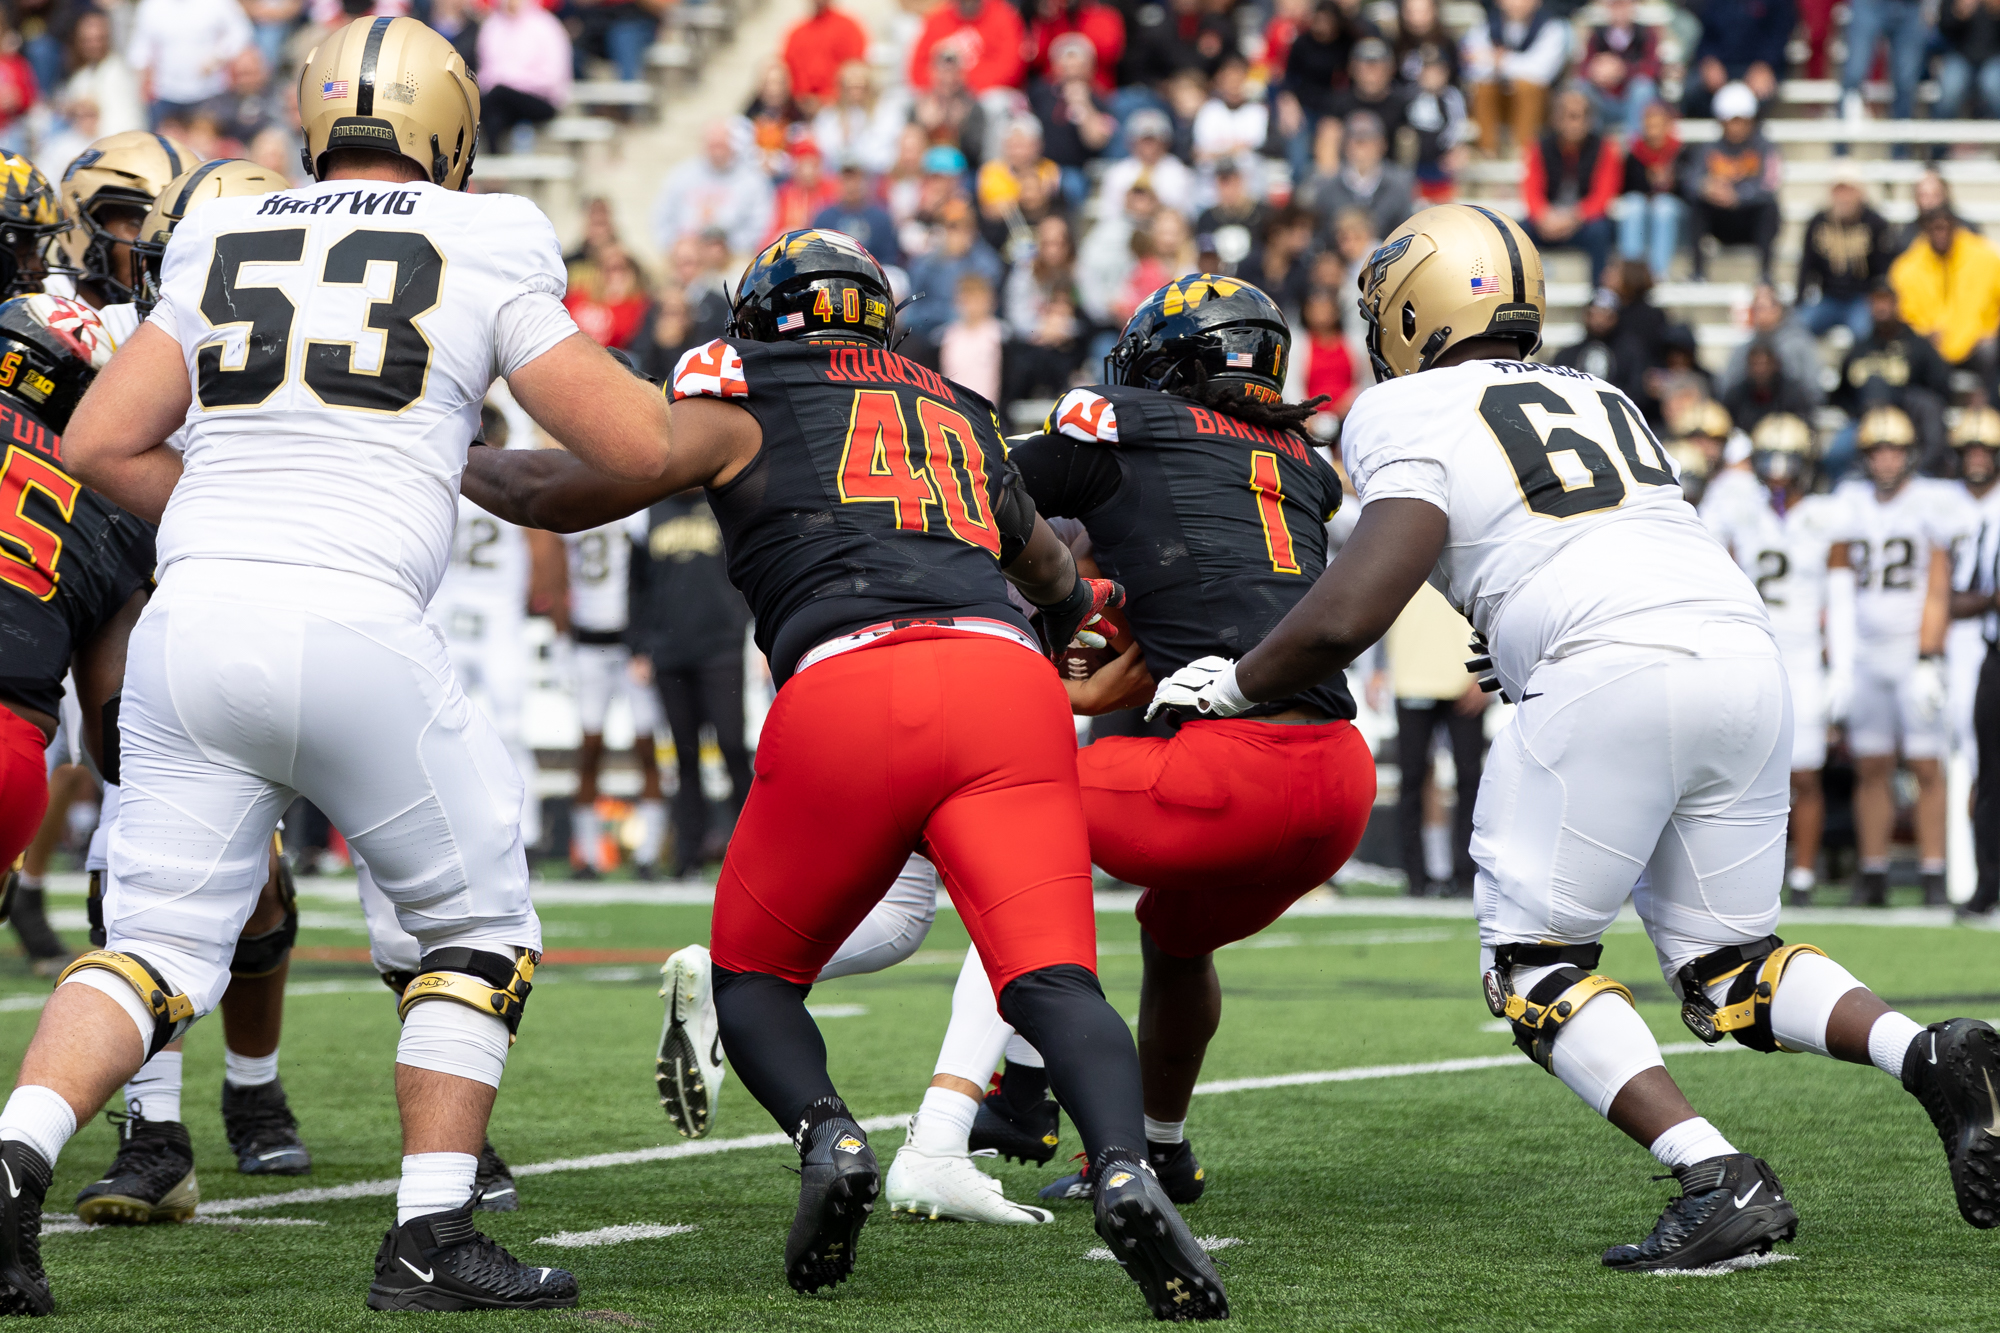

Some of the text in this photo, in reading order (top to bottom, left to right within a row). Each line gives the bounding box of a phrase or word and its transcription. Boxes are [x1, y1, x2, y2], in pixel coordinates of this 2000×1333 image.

[332, 125, 394, 140] BOILERMAKERS
[256, 190, 422, 216] HARTWIG
[197, 224, 448, 416] 53
[813, 287, 860, 323] 40
[0, 351, 24, 388] 5
[825, 348, 957, 404] JOHNSON
[0, 402, 64, 463] FULL
[1186, 406, 1312, 467] BARHAM
[1474, 380, 1682, 523] 64
[836, 388, 1002, 561] 40
[0, 443, 82, 603] 5
[1249, 449, 1302, 575] 1
